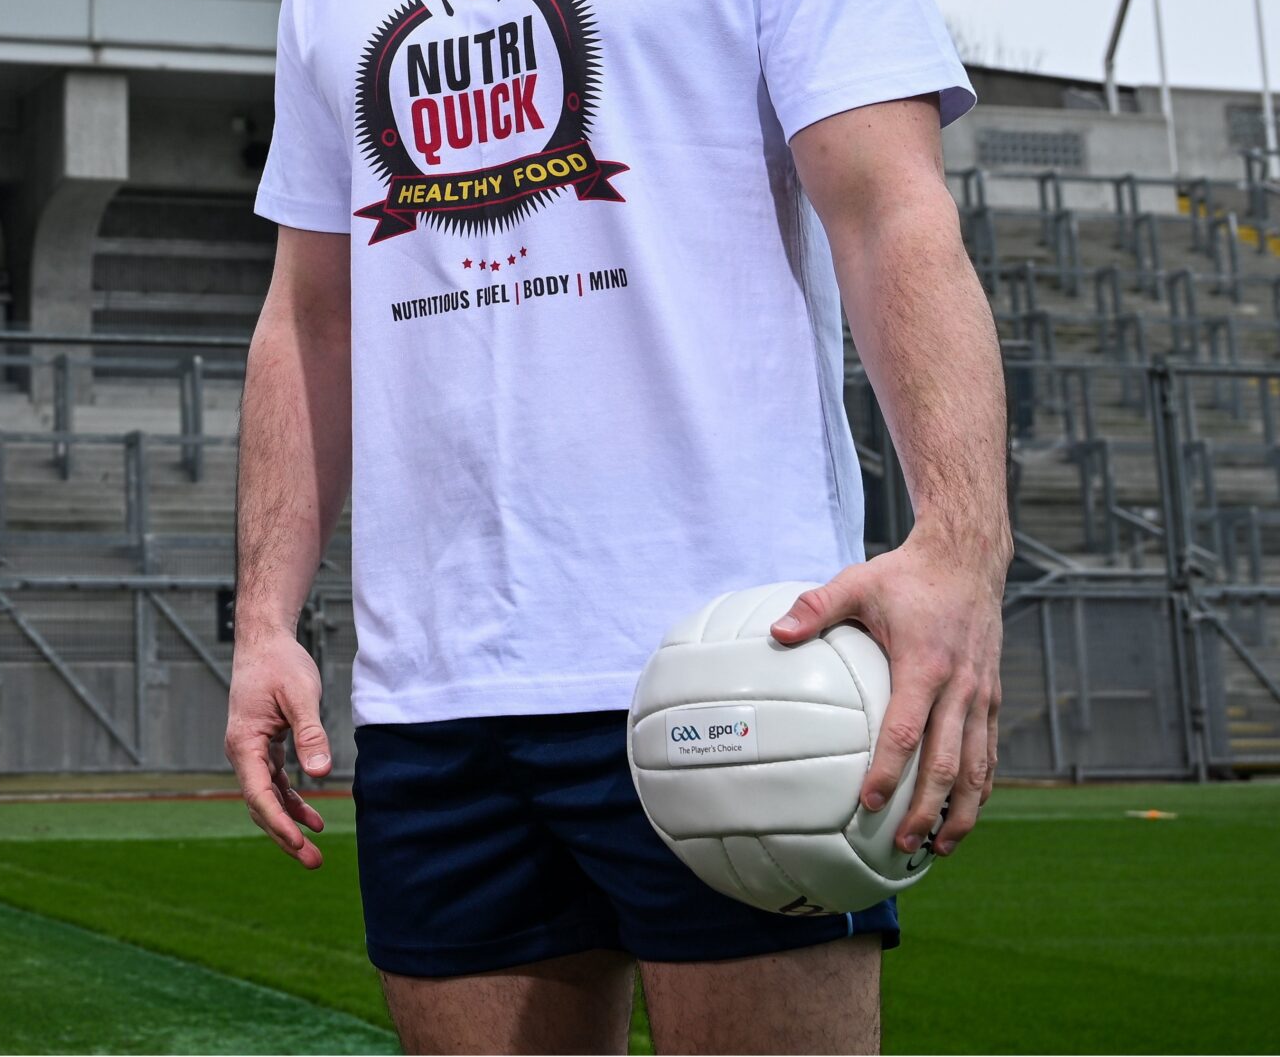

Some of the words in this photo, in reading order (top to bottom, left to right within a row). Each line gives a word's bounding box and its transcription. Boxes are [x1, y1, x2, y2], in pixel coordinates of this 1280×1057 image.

[406, 14, 538, 97] NUTRI
[411, 73, 545, 166] QUICK
[398, 174, 503, 205] HEALTHY
[513, 152, 588, 188] FOOD
[391, 289, 470, 322] NUTRITIOUS
[476, 283, 511, 307] FUEL
[523, 274, 569, 299] BODY
[589, 268, 628, 292] MIND
[671, 725, 701, 742] GAA
[708, 724, 733, 739] gpa
[679, 746, 691, 755] The
[692, 745, 716, 756] Player's
[717, 744, 742, 752] Choice
